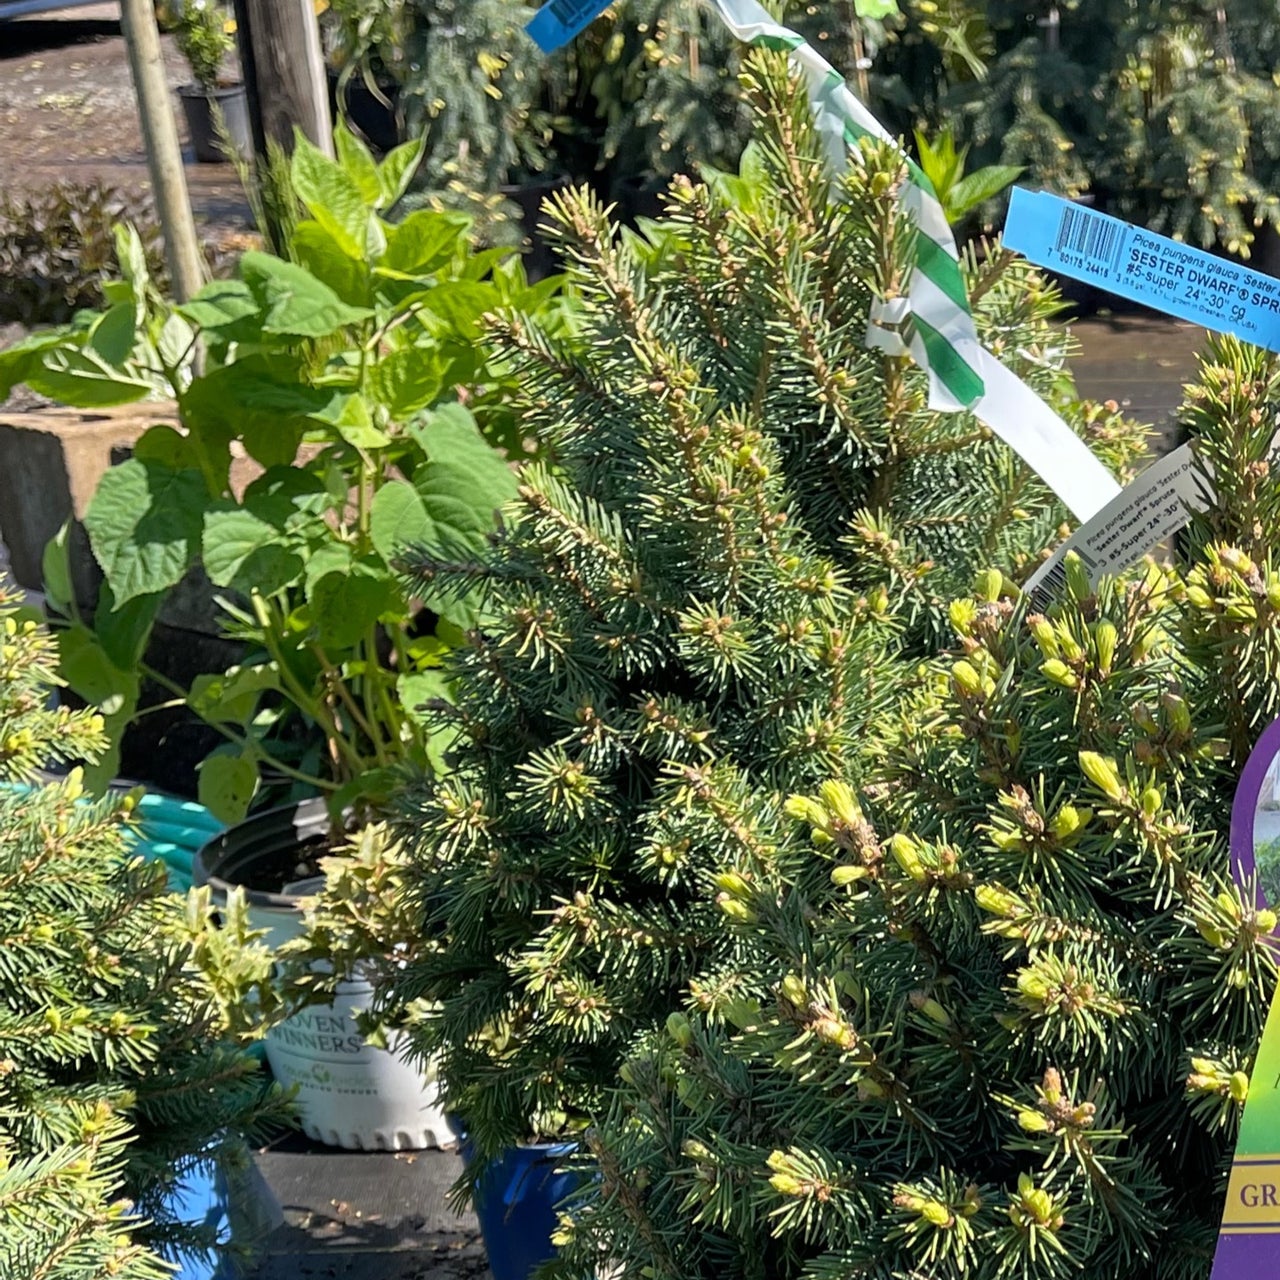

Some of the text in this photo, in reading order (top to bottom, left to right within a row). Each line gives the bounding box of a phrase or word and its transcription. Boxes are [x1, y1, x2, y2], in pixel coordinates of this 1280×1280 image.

[1129, 247, 1184, 278] 'SESTER
[1132, 233, 1160, 251] Picea
[1161, 247, 1205, 268] pungens
[1206, 263, 1240, 281] glauca
[1126, 262, 1179, 291] #5-super
[1231, 305, 1246, 320] cg
[1148, 488, 1176, 509] Spruce
